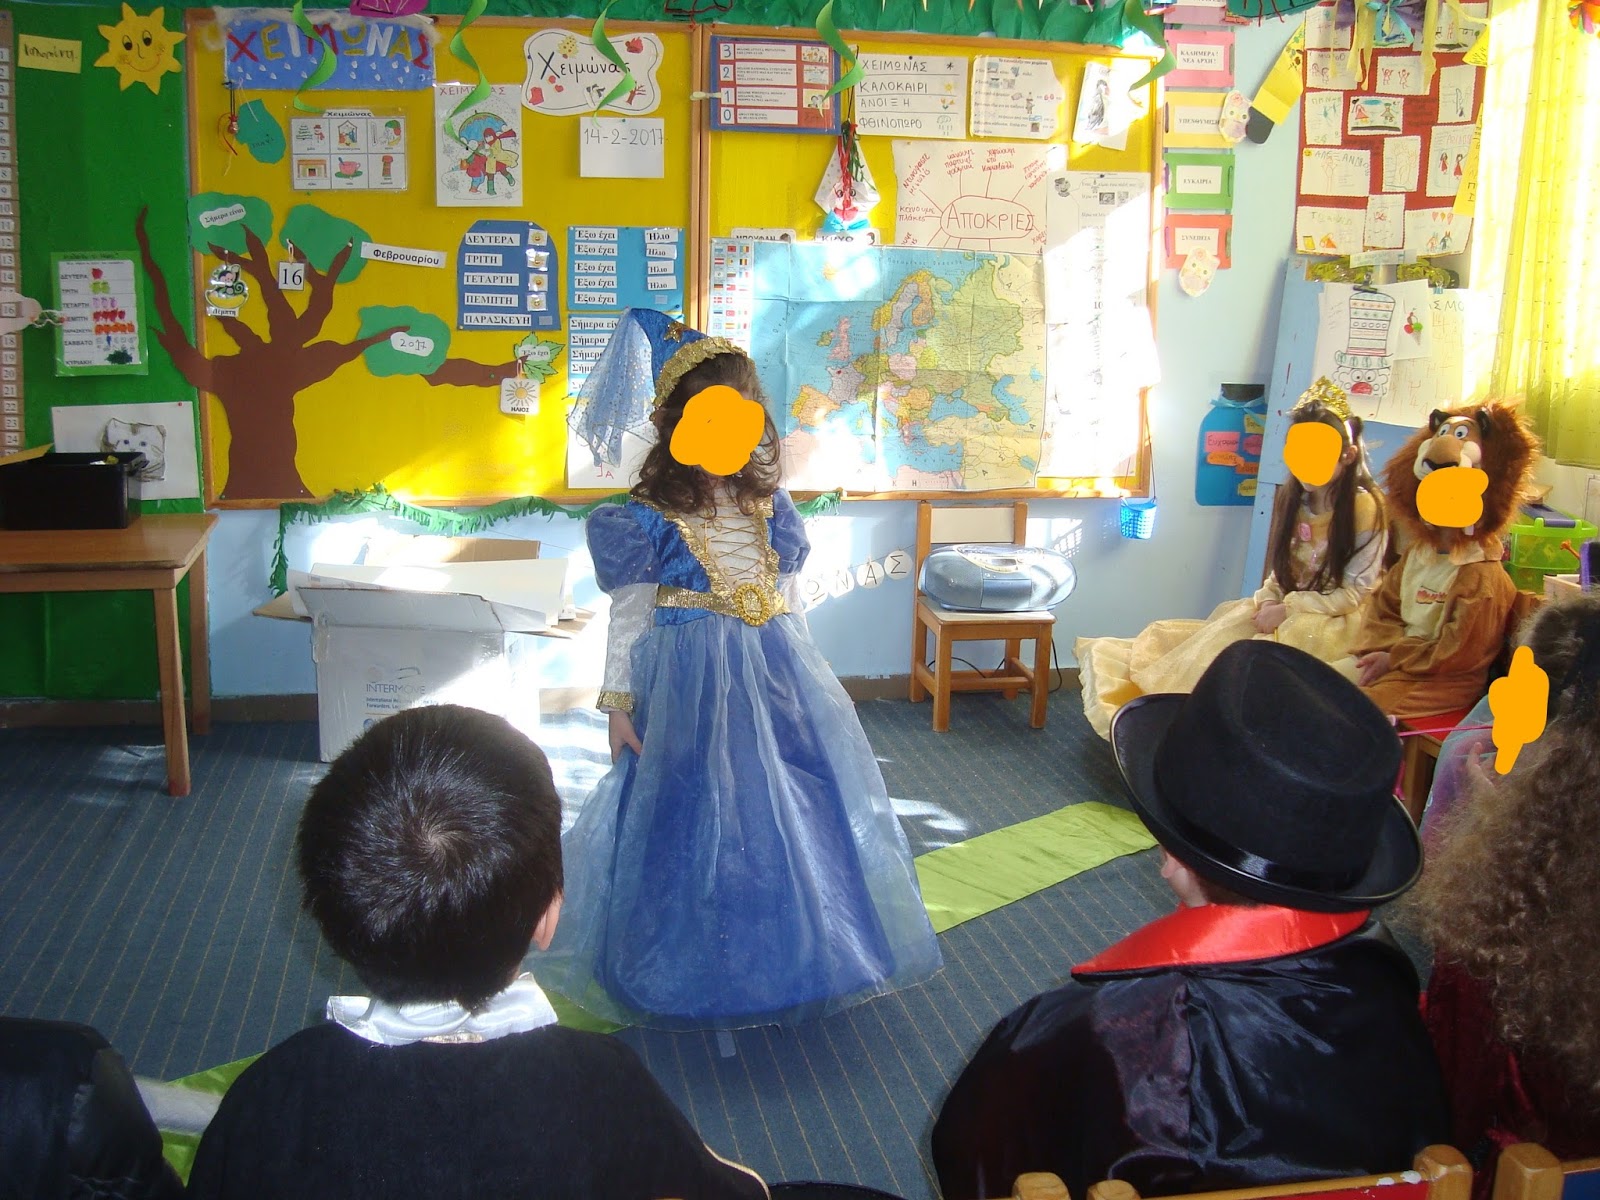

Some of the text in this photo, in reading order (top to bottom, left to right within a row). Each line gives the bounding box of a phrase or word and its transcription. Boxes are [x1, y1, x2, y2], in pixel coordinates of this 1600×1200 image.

[227, 22, 430, 69] ΧΕΙΜΩΝΑΣ
[723, 44, 731, 58] 3
[862, 59, 928, 73] ΧΕΙΜΩΝΑΣ
[723, 66, 730, 79] 2
[439, 85, 506, 97] ΧΕΙΜΑΣ
[859, 81, 928, 94] ΚΑΛΟΚΑΙΡΙ
[724, 90, 730, 103] 1
[860, 98, 910, 108] ΑΝΟΙΞΗ
[723, 109, 731, 121] 0
[859, 116, 923, 129] ΦΘΙΝΟΠΩΡΟ
[583, 127, 664, 145] 14-2-2017
[204, 207, 244, 224] Σήμερα είναι
[946, 203, 1035, 231] ΑΠΟΚΡΙΕΣ
[467, 235, 514, 244] ΔΕΥΤΕΡΑ
[576, 230, 615, 240] Έξω έχει
[647, 232, 670, 241] Ήλιο
[575, 245, 615, 255] Έξω έχει
[2, 256, 12, 264] 13
[373, 248, 440, 265] Φεβρουαρίου
[466, 255, 497, 264] ΤΡΙΤΗ
[575, 263, 615, 273] Έξω έχει
[282, 267, 303, 286] 16
[465, 275, 513, 284] ΤΕΤΑΡΤΗ
[575, 278, 615, 288] Έξω έχει
[466, 295, 513, 305] ΠΕΜΠΤΗ
[575, 294, 615, 304] Έξω έχει
[4, 307, 15, 315] 16
[465, 315, 530, 325] ΠΑΡΑΣΚΕΥΗ
[571, 319, 604, 330] Σήμερα
[4, 338, 14, 346] 18
[399, 338, 427, 351] 2017
[572, 335, 605, 346] Σήμερα
[4, 354, 15, 362] 19
[4, 370, 14, 378] 20
[4, 387, 14, 395] 21
[5, 403, 16, 411] 22
[6, 419, 17, 427] 23
[7, 435, 18, 443] 24
[366, 683, 426, 695] INTERMOVE
